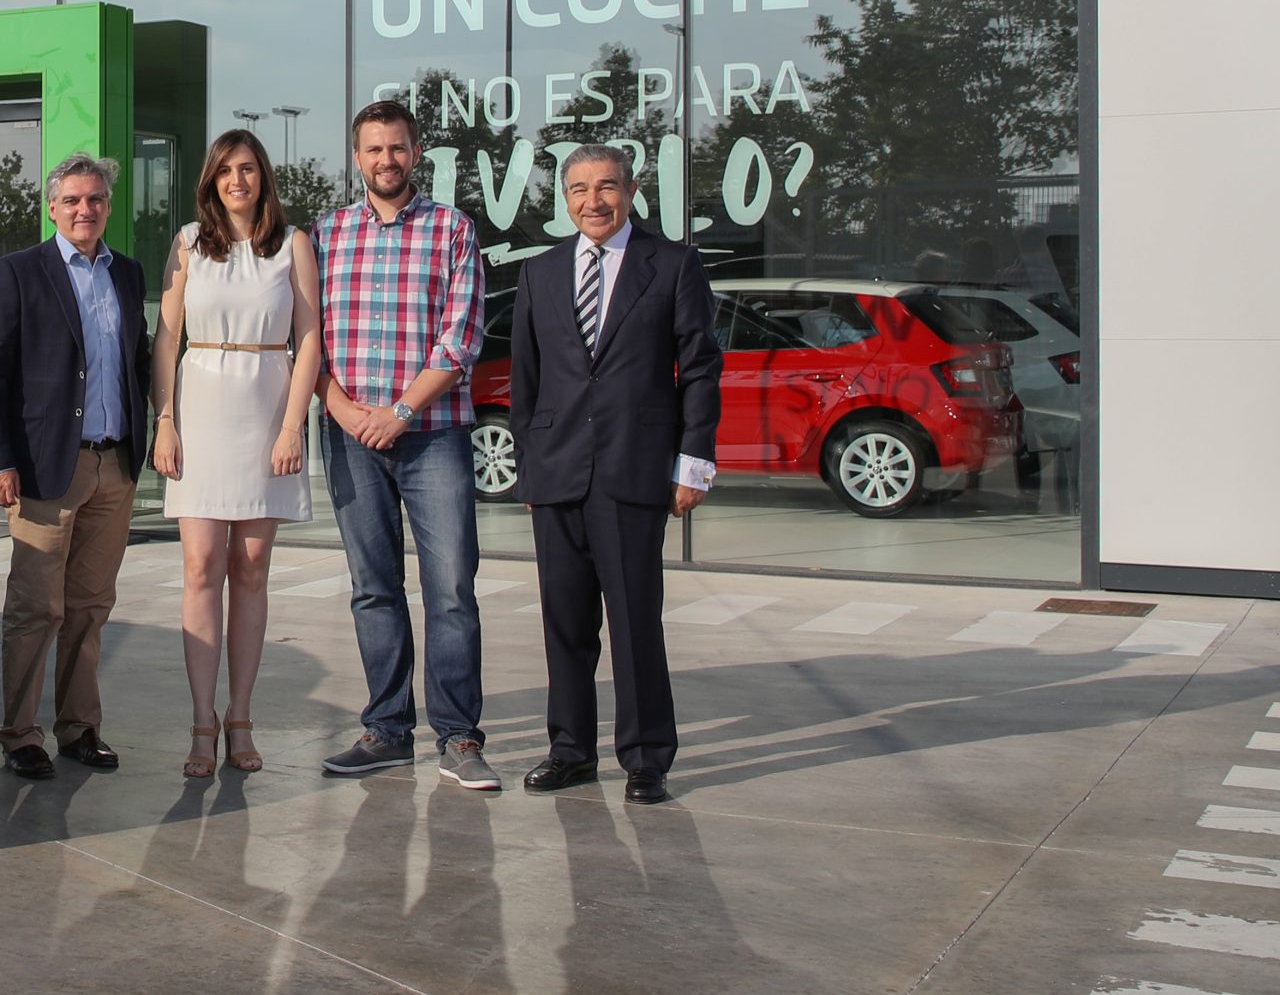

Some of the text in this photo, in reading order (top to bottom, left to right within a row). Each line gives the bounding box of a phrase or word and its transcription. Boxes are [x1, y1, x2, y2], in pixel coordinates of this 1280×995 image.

[441, 76, 521, 129] NO
[545, 70, 615, 125] ES
[637, 60, 811, 120] PARA
